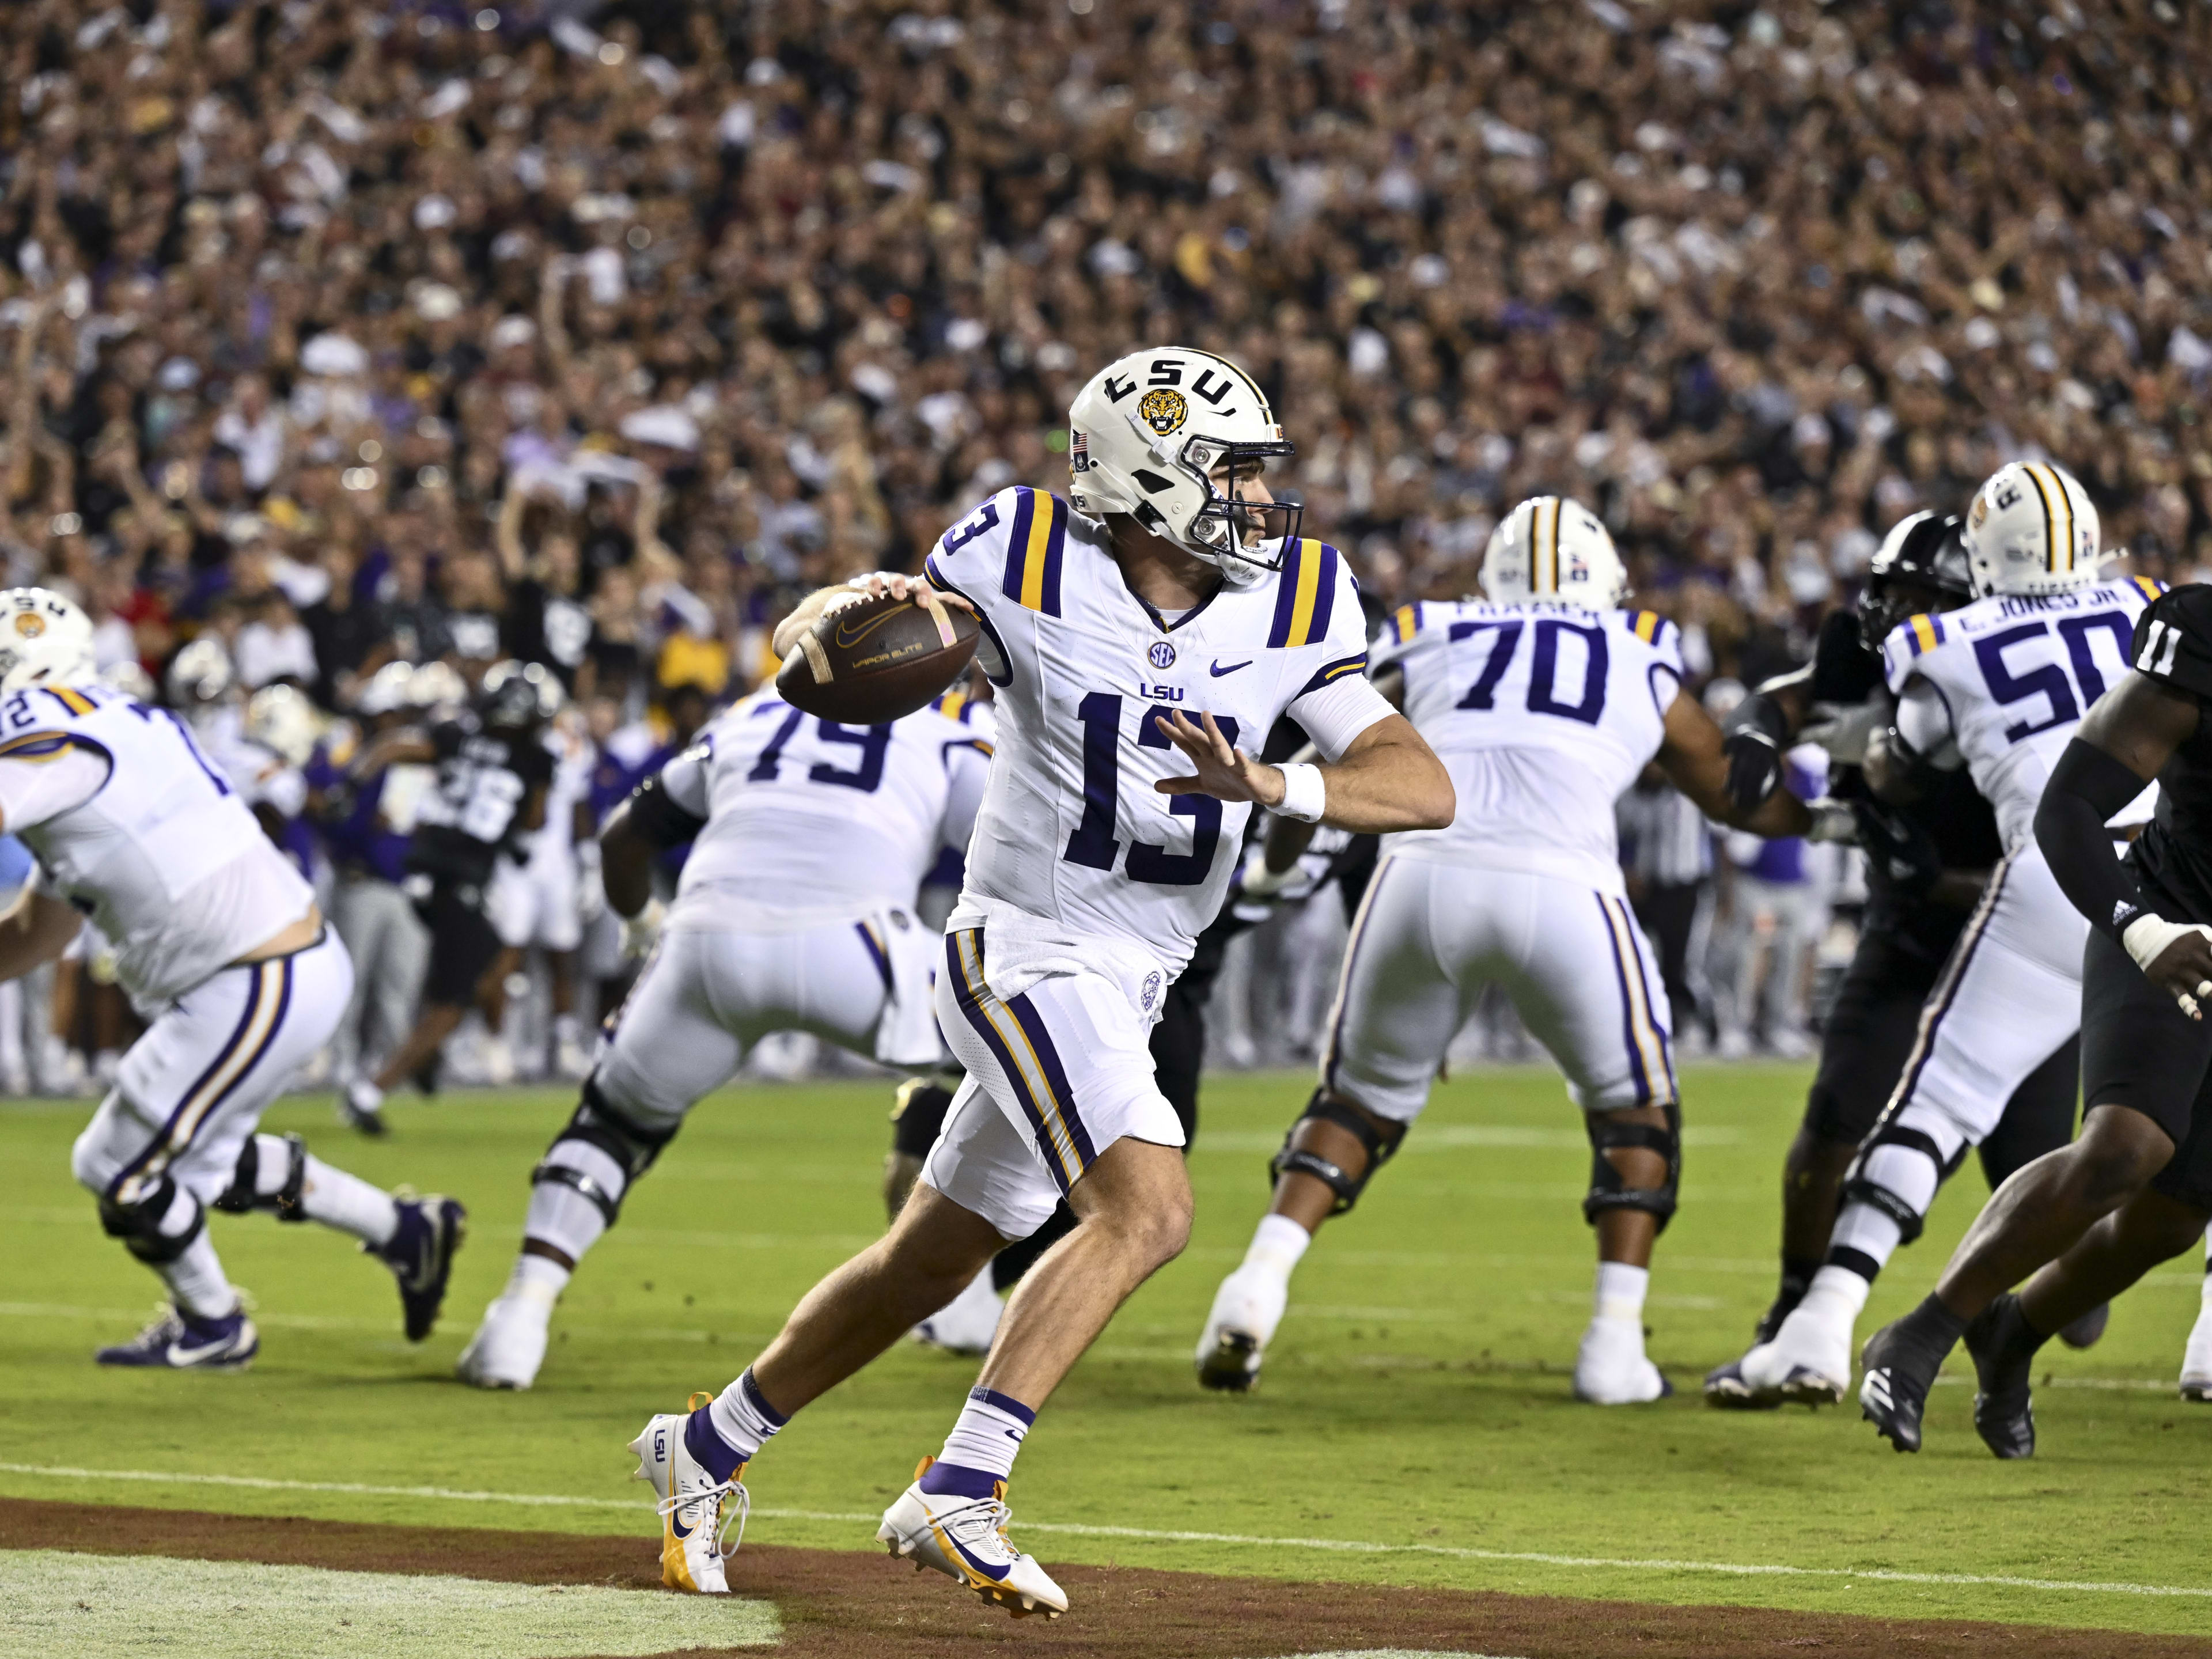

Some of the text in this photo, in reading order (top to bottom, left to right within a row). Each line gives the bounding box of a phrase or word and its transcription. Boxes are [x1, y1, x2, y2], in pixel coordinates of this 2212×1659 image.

[1104, 360, 1233, 405] LSU
[943, 497, 999, 556] 3
[853, 642, 923, 669] VAPOR ELITE
[1150, 643, 1175, 669] SEC
[1449, 620, 1609, 727] 70
[2137, 619, 2182, 676] 11
[1140, 683, 1184, 702] LSU
[1973, 611, 2135, 744] 50
[747, 700, 894, 794] 79
[1063, 691, 1240, 886] 13
[654, 1429, 665, 1463] LSU
